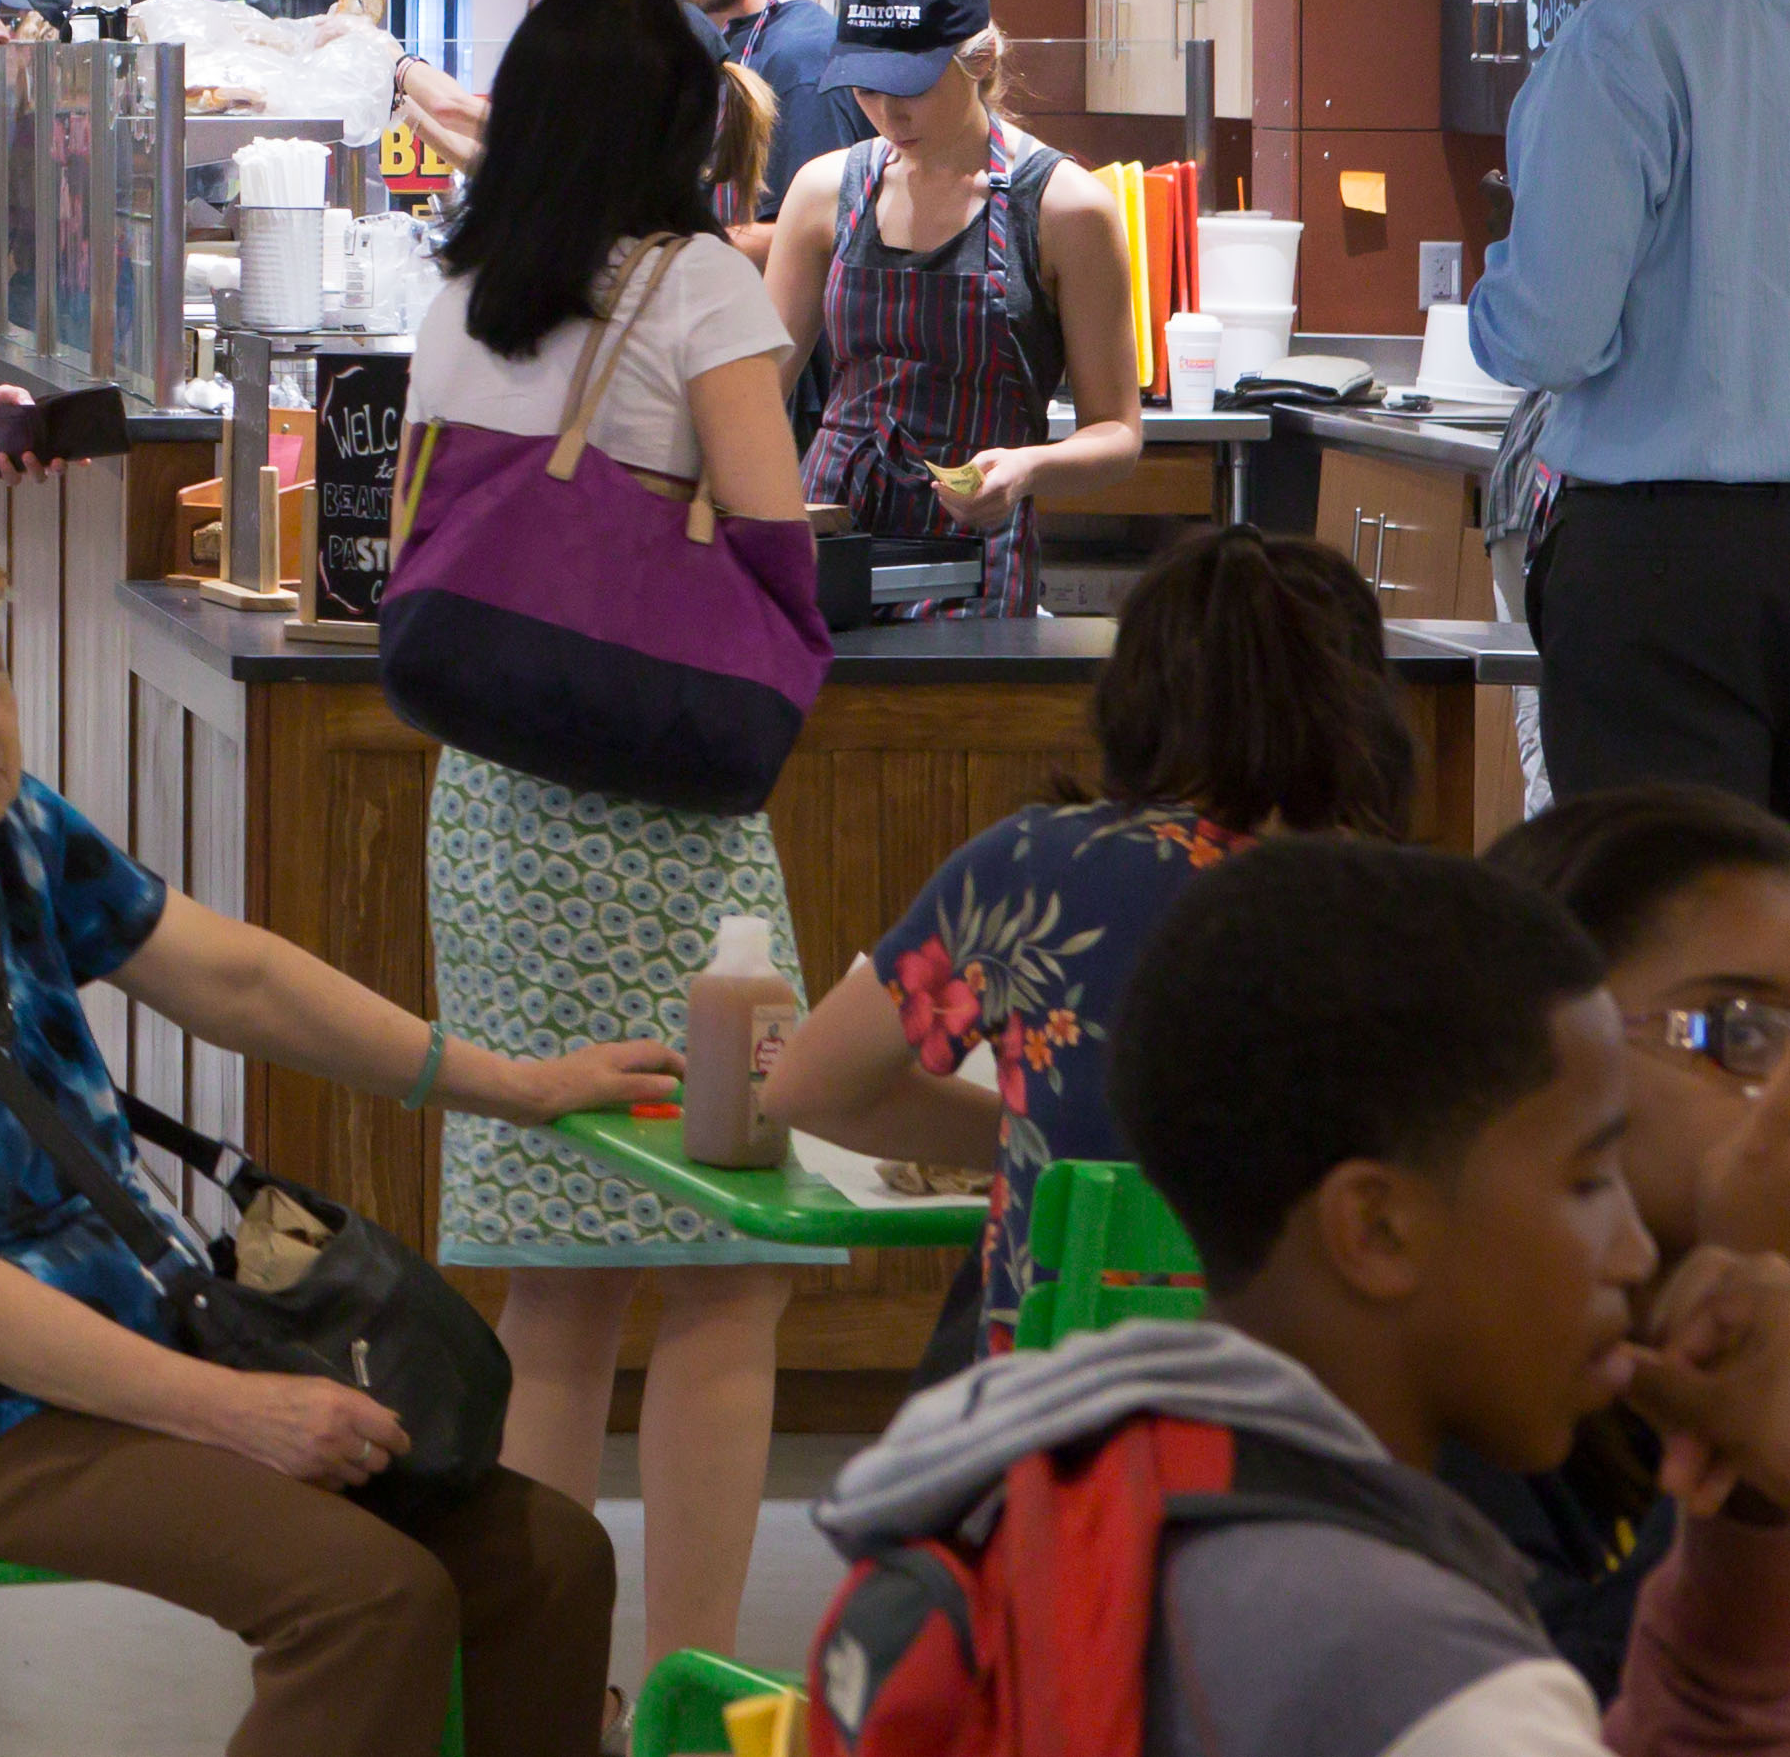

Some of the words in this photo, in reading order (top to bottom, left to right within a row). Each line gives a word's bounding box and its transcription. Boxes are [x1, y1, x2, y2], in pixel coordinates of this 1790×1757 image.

[327, 403, 398, 460] WELC
[375, 458, 397, 479] to
[323, 482, 394, 520] BEAN
[328, 534, 389, 572] PAST
